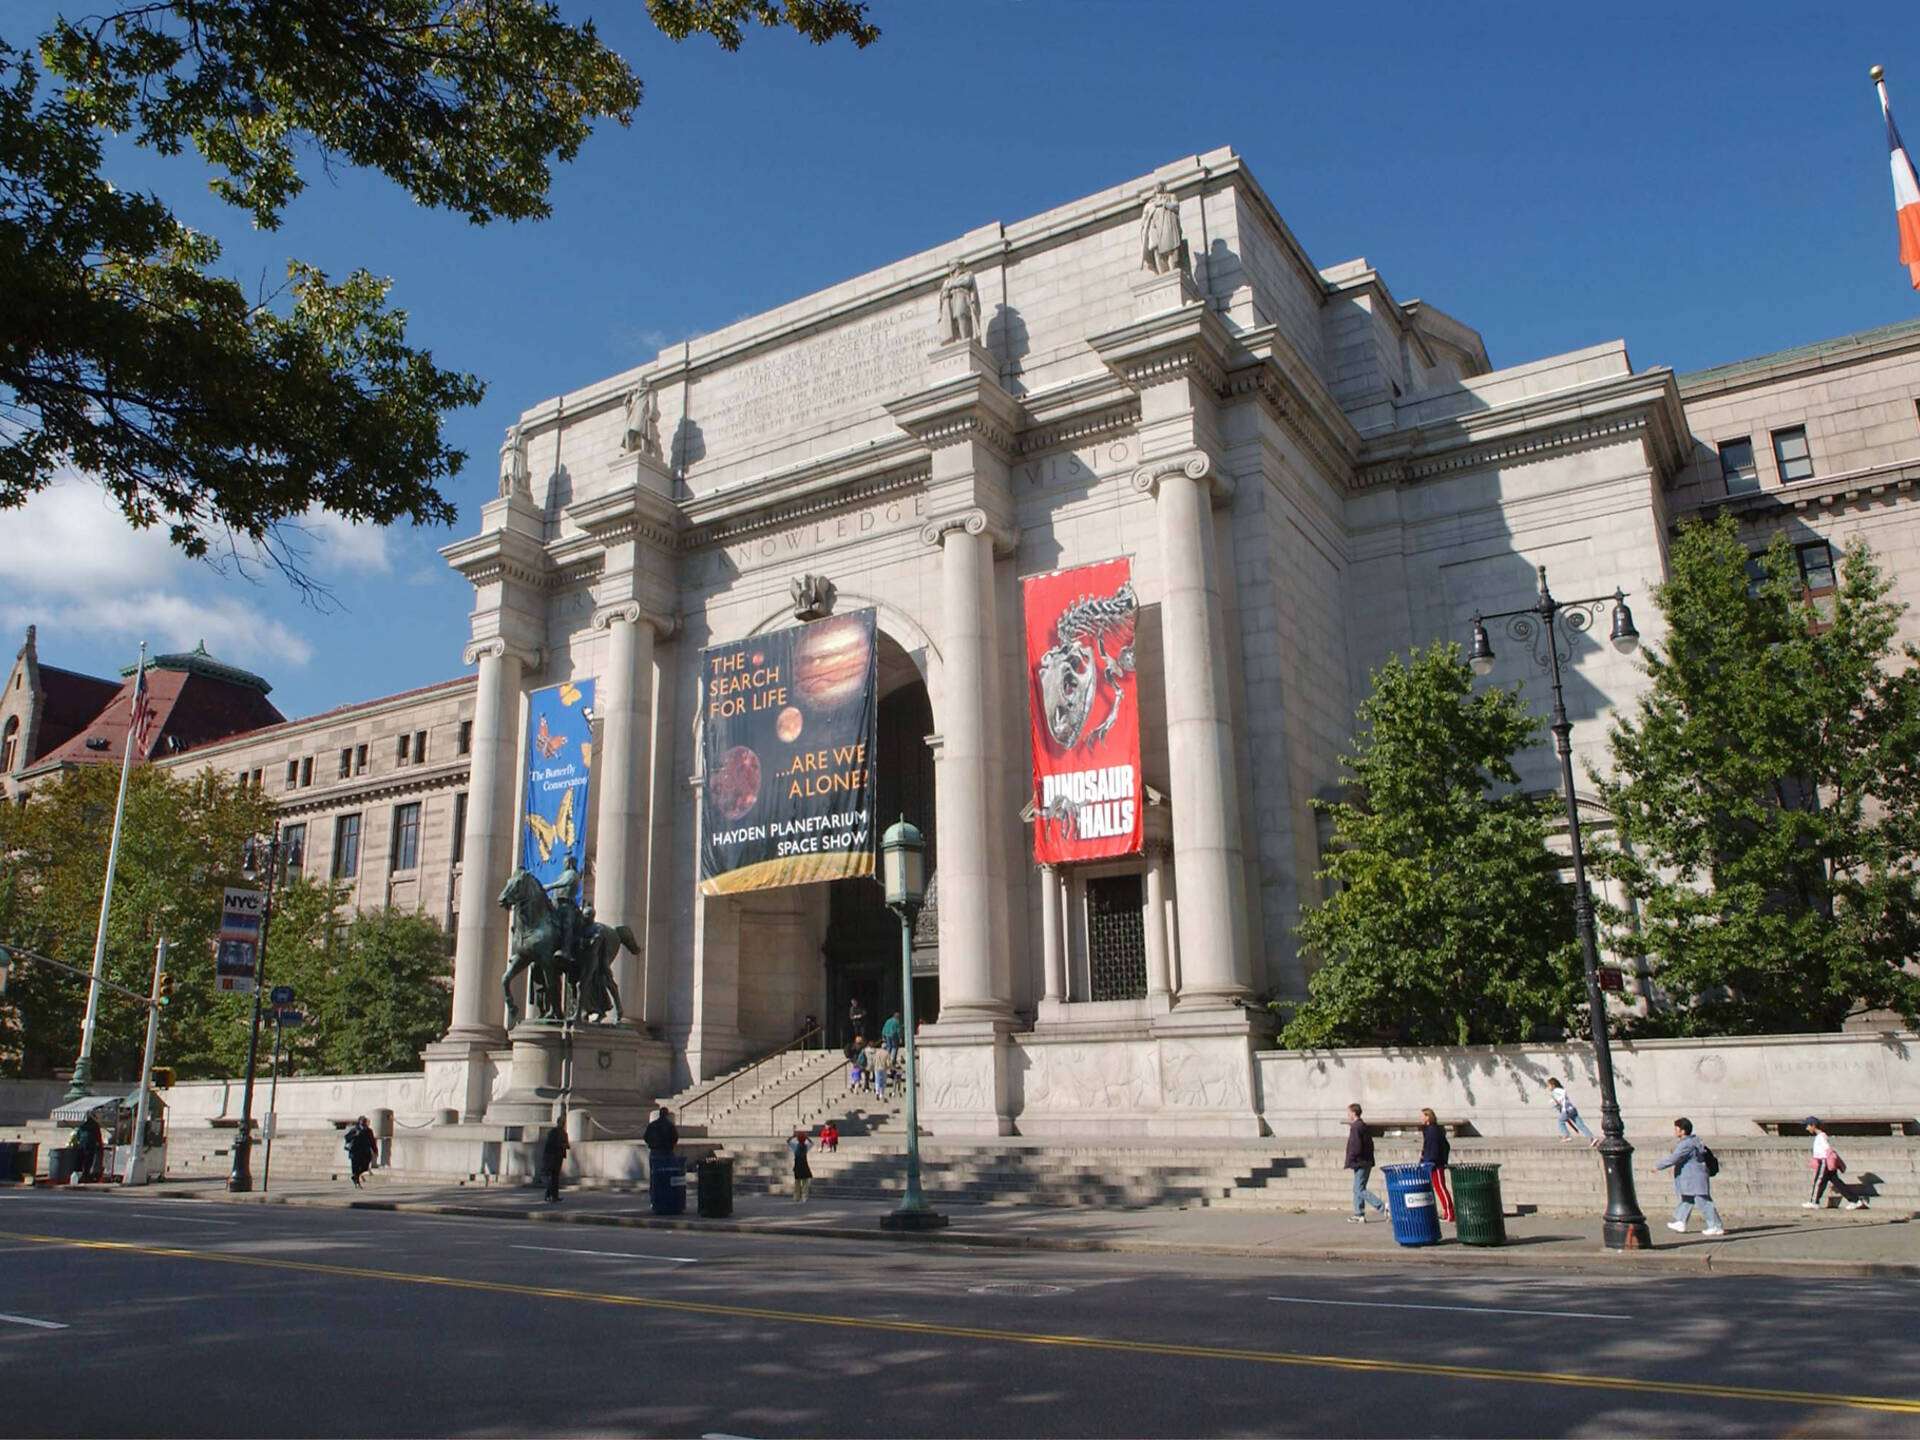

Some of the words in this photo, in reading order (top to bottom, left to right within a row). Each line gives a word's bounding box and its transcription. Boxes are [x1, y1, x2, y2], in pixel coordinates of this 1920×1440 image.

[751, 354, 816, 387] THEODORE
[819, 327, 892, 363] ROOSEVELT
[1024, 441, 1129, 485] VISIO
[717, 495, 926, 569] KNOWLEDGE
[712, 651, 745, 675] THE
[709, 666, 780, 697] SEARCH
[709, 698, 746, 719] FOR
[753, 687, 787, 711] LIFE
[833, 743, 865, 766] WE
[531, 770, 545, 782] The
[545, 763, 576, 778] Butterfly
[788, 769, 868, 799] ALONE?
[1042, 765, 1134, 808] DINOSAUR
[713, 825, 766, 846] HAYDEN
[770, 809, 867, 837] PLANETARIUM
[1080, 799, 1134, 839] HALLS
[777, 836, 818, 857] SPACE
[822, 830, 867, 850] SHOW
[225, 894, 258, 909] NYC
